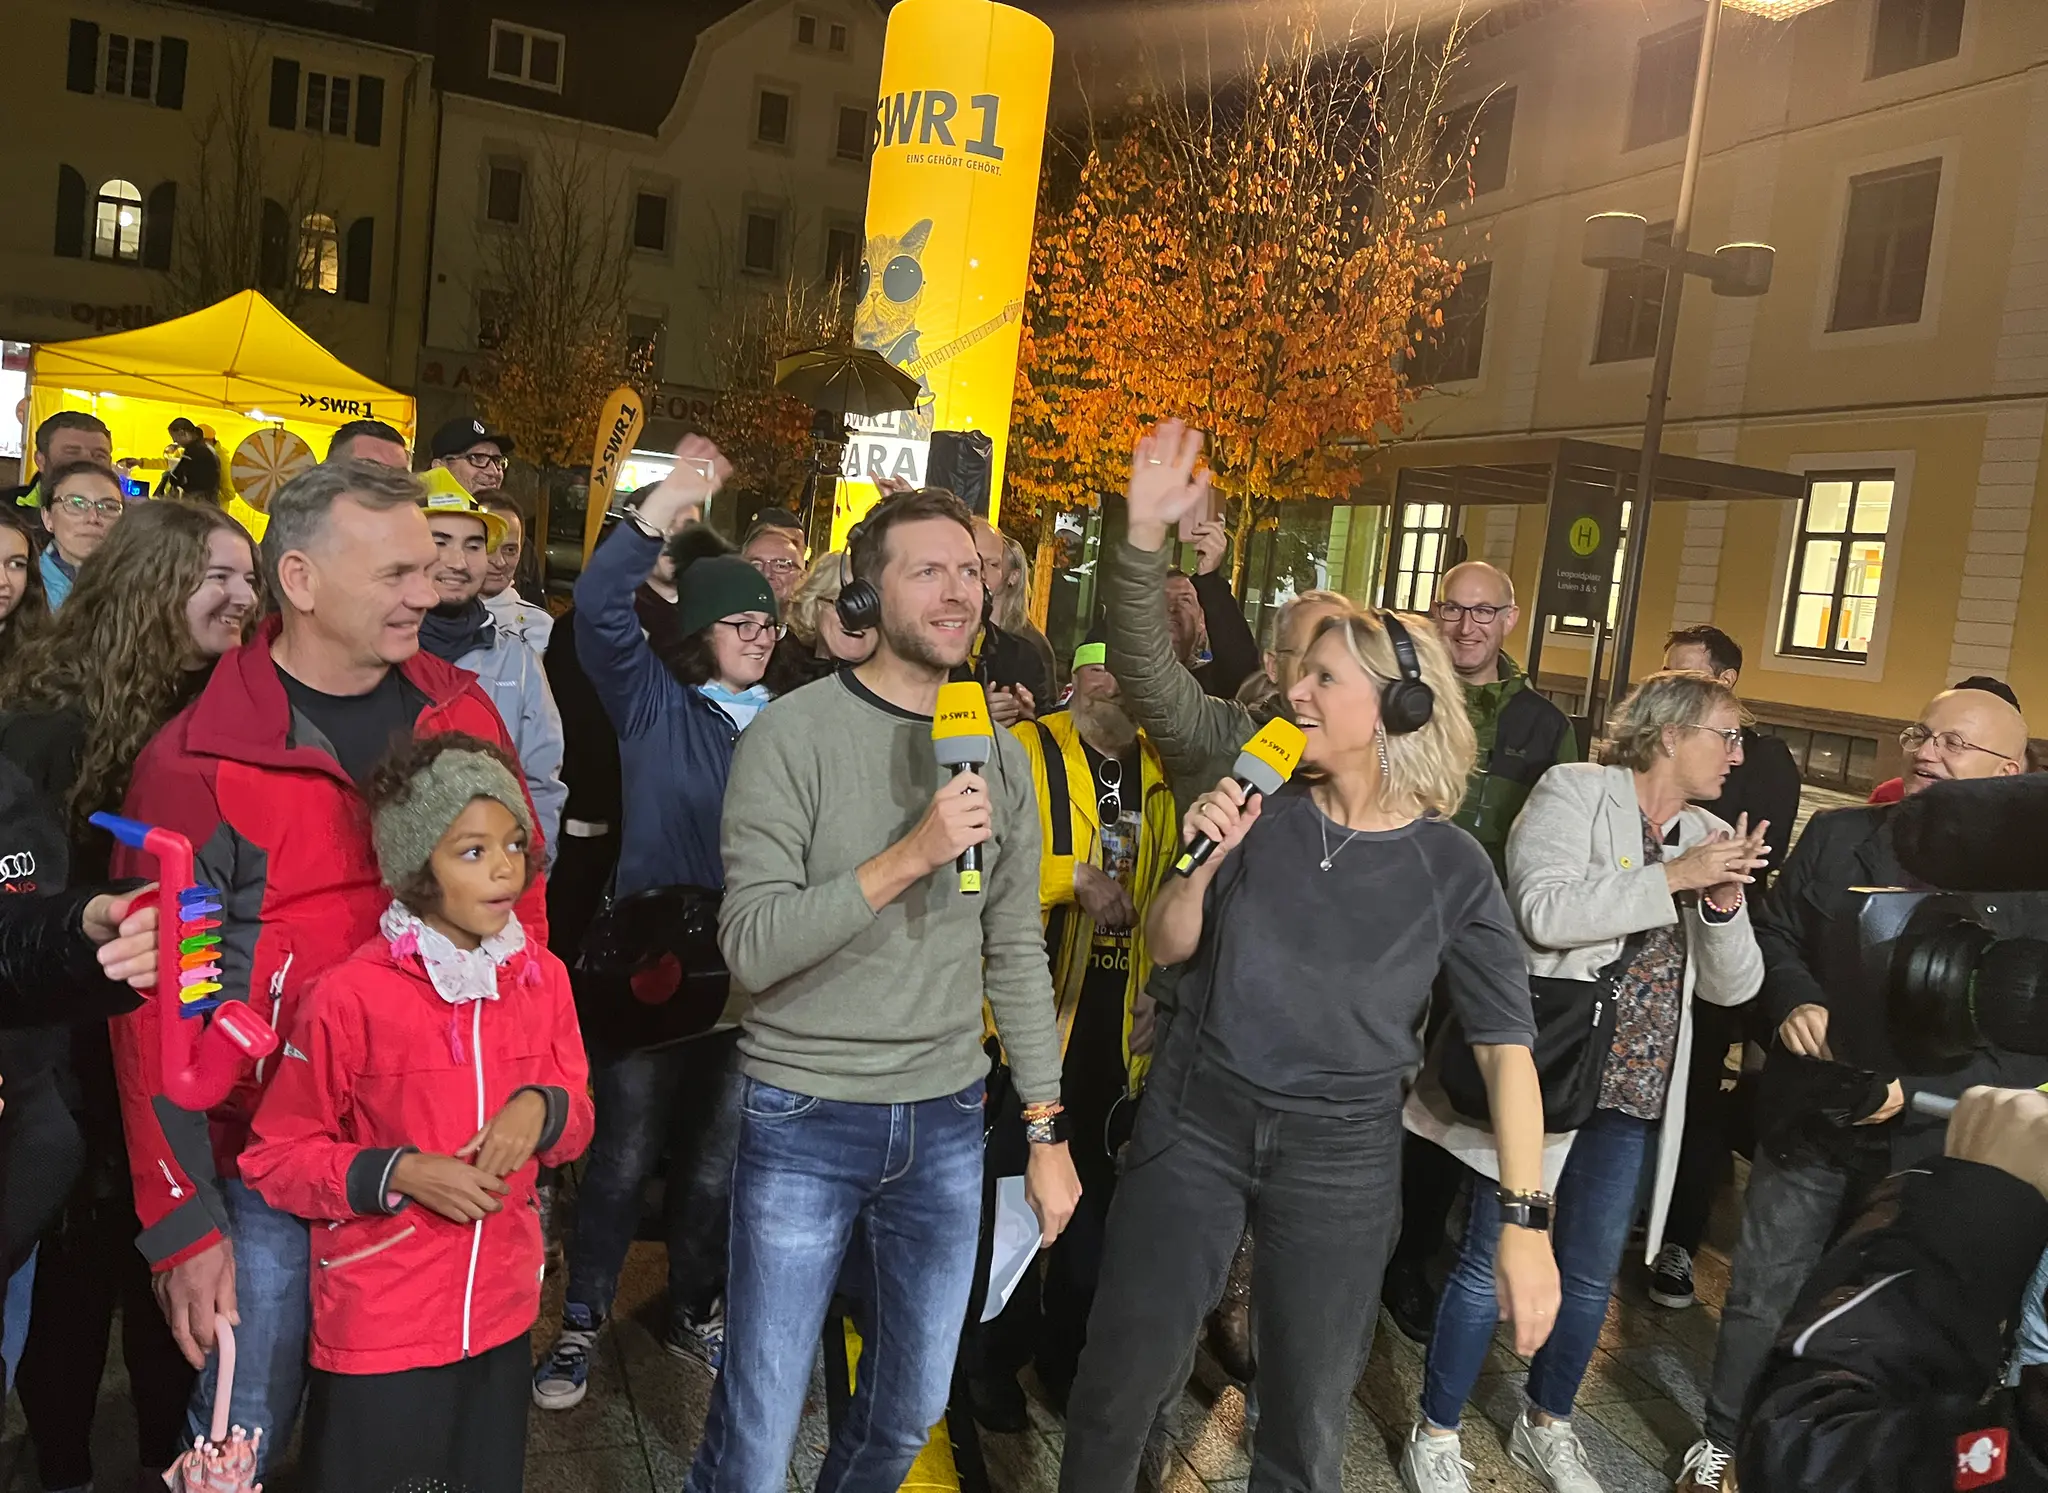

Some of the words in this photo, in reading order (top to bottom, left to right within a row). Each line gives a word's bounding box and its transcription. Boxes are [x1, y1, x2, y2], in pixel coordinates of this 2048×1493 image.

[906, 154, 925, 164] EINS
[927, 154, 963, 167] GEHÖRT
[966, 159, 1002, 177] GEHÖRT.
[1577, 525, 1593, 547] H
[1556, 568, 1601, 582] Leopoldplatz
[1557, 581, 1579, 591] Linien
